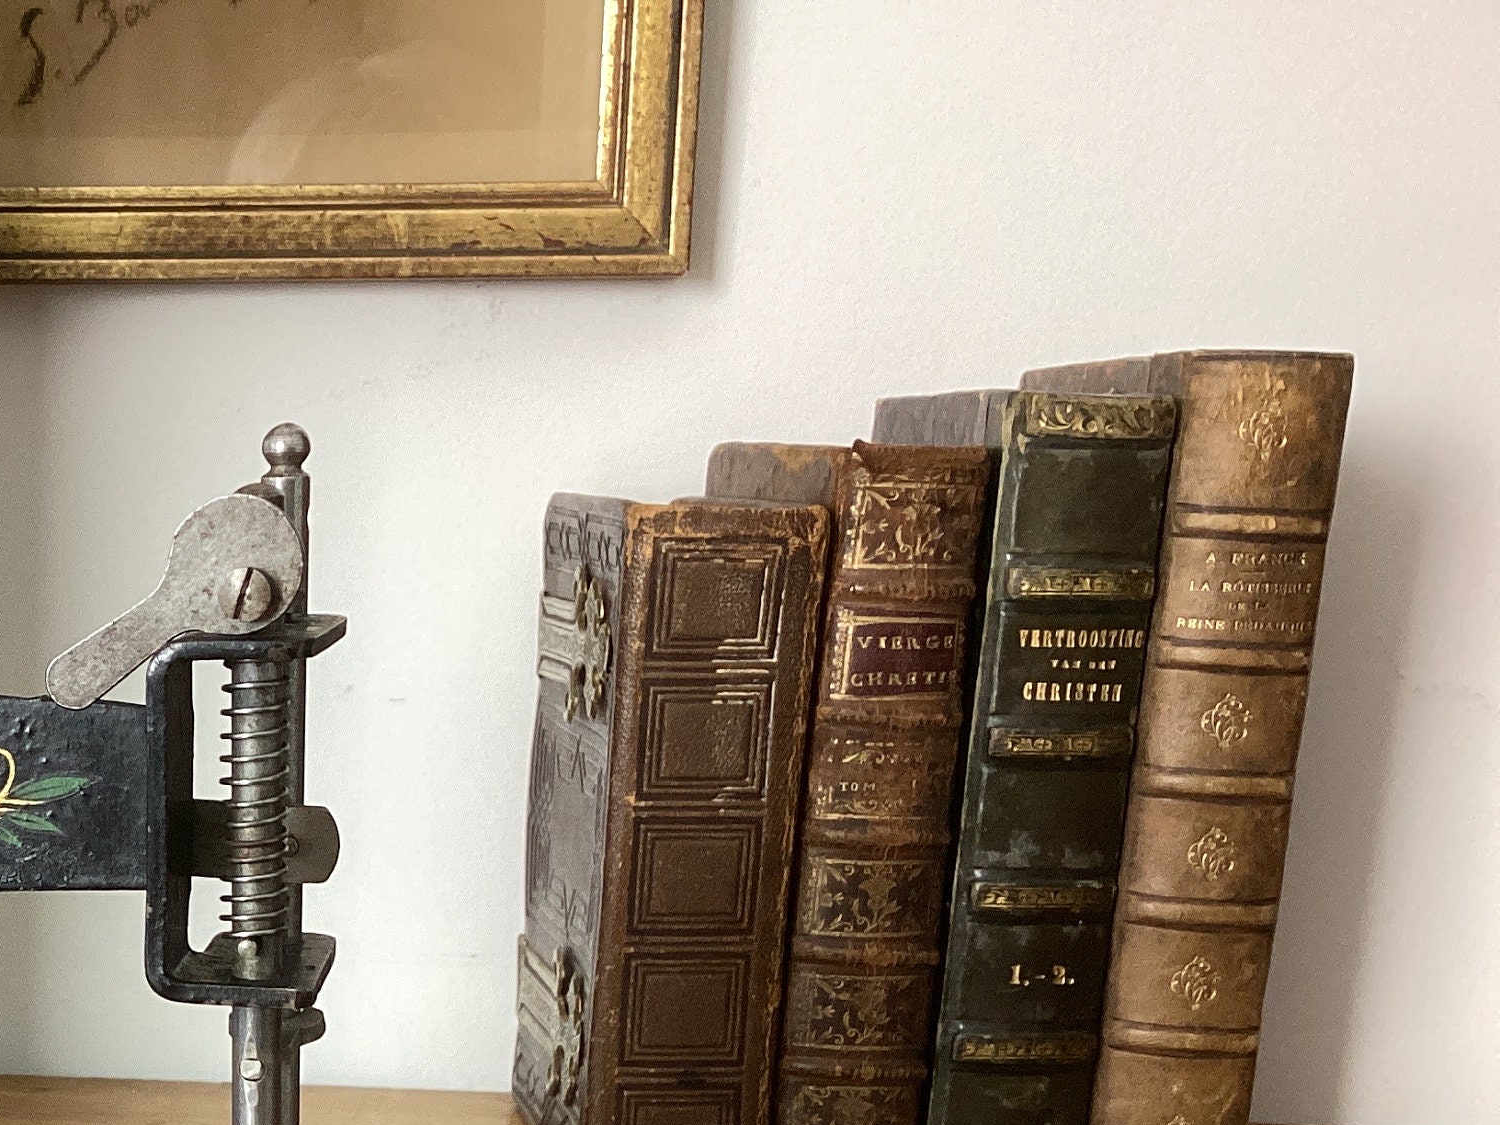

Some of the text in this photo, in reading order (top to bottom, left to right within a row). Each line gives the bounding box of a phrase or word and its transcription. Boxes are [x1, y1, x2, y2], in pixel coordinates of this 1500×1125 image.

[1189, 580, 1211, 592] LA
[1176, 617, 1226, 630] REINE
[857, 635, 954, 650] VIERGE
[1020, 629, 1144, 648] VERTROOSTING
[1050, 659, 1080, 669] VAN
[1023, 682, 1122, 702] CHRISTEN
